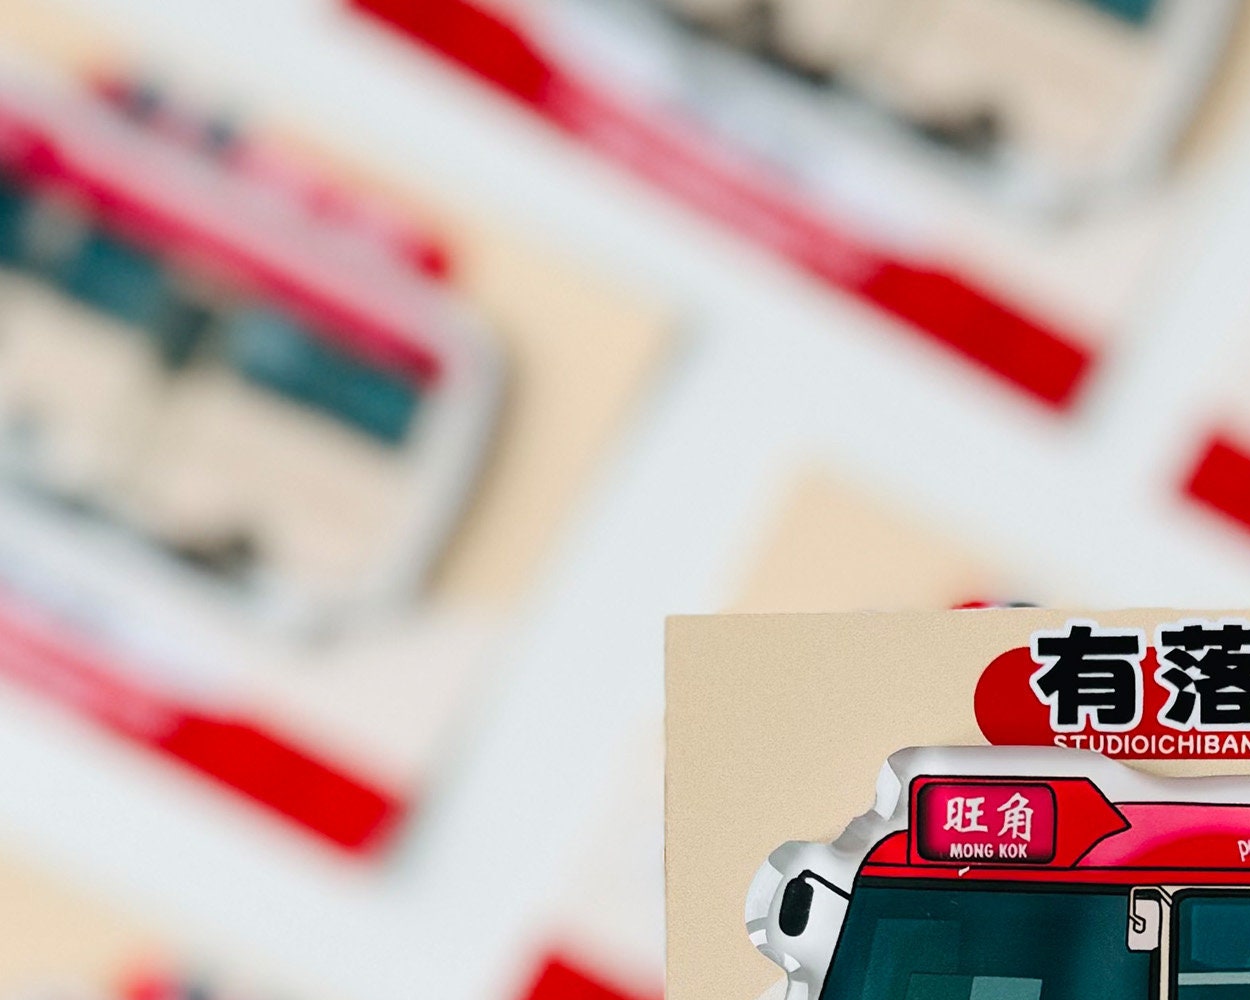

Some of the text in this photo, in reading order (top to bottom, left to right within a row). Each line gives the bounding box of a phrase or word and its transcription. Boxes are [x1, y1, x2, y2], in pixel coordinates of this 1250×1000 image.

[942, 792, 1034, 842] 旺角
[950, 843, 1028, 859] MONG KOK
